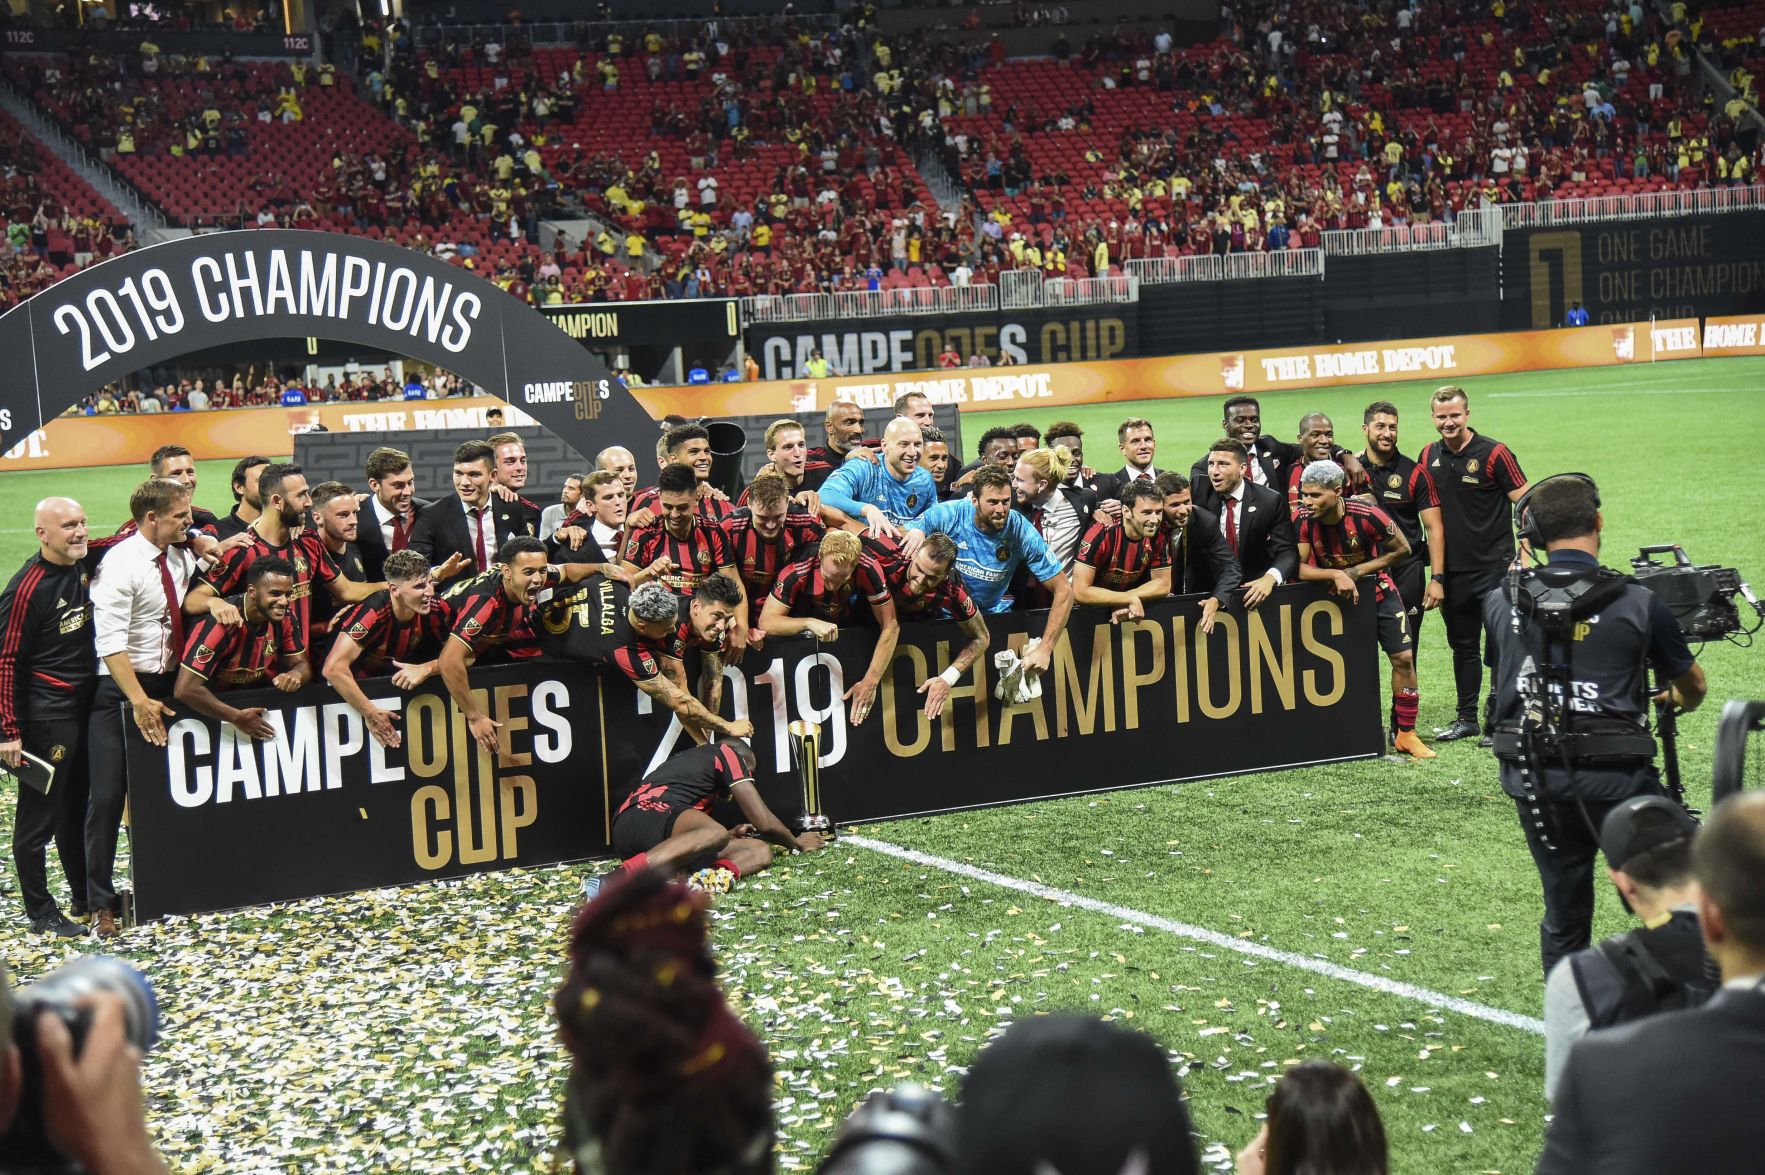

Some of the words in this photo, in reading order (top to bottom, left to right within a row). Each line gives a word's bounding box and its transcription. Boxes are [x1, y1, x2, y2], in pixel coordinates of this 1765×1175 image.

[6, 31, 34, 43] 112C
[283, 37, 308, 49] 112C
[1599, 231, 1641, 263] ONE
[1650, 224, 1712, 260] GAME
[1599, 271, 1642, 303] ONE
[53, 268, 185, 371] 2019
[191, 249, 482, 353] CHAMPIONS
[546, 312, 619, 338] AMPION
[1040, 317, 1125, 362] CUP
[1652, 327, 1697, 352] THE
[1703, 323, 1757, 348] HOME
[1261, 355, 1311, 381] THE
[1314, 350, 1379, 377] HOME
[524, 379, 610, 404] CAMPEONES
[836, 383, 891, 409] THE
[574, 401, 602, 420] CUP
[599, 580, 615, 635] VILLALBA
[1395, 612, 1407, 634] 7
[881, 600, 1346, 758] CHAMPIONS
[166, 680, 573, 808] CAMPEONES
[410, 775, 539, 871] CUP
